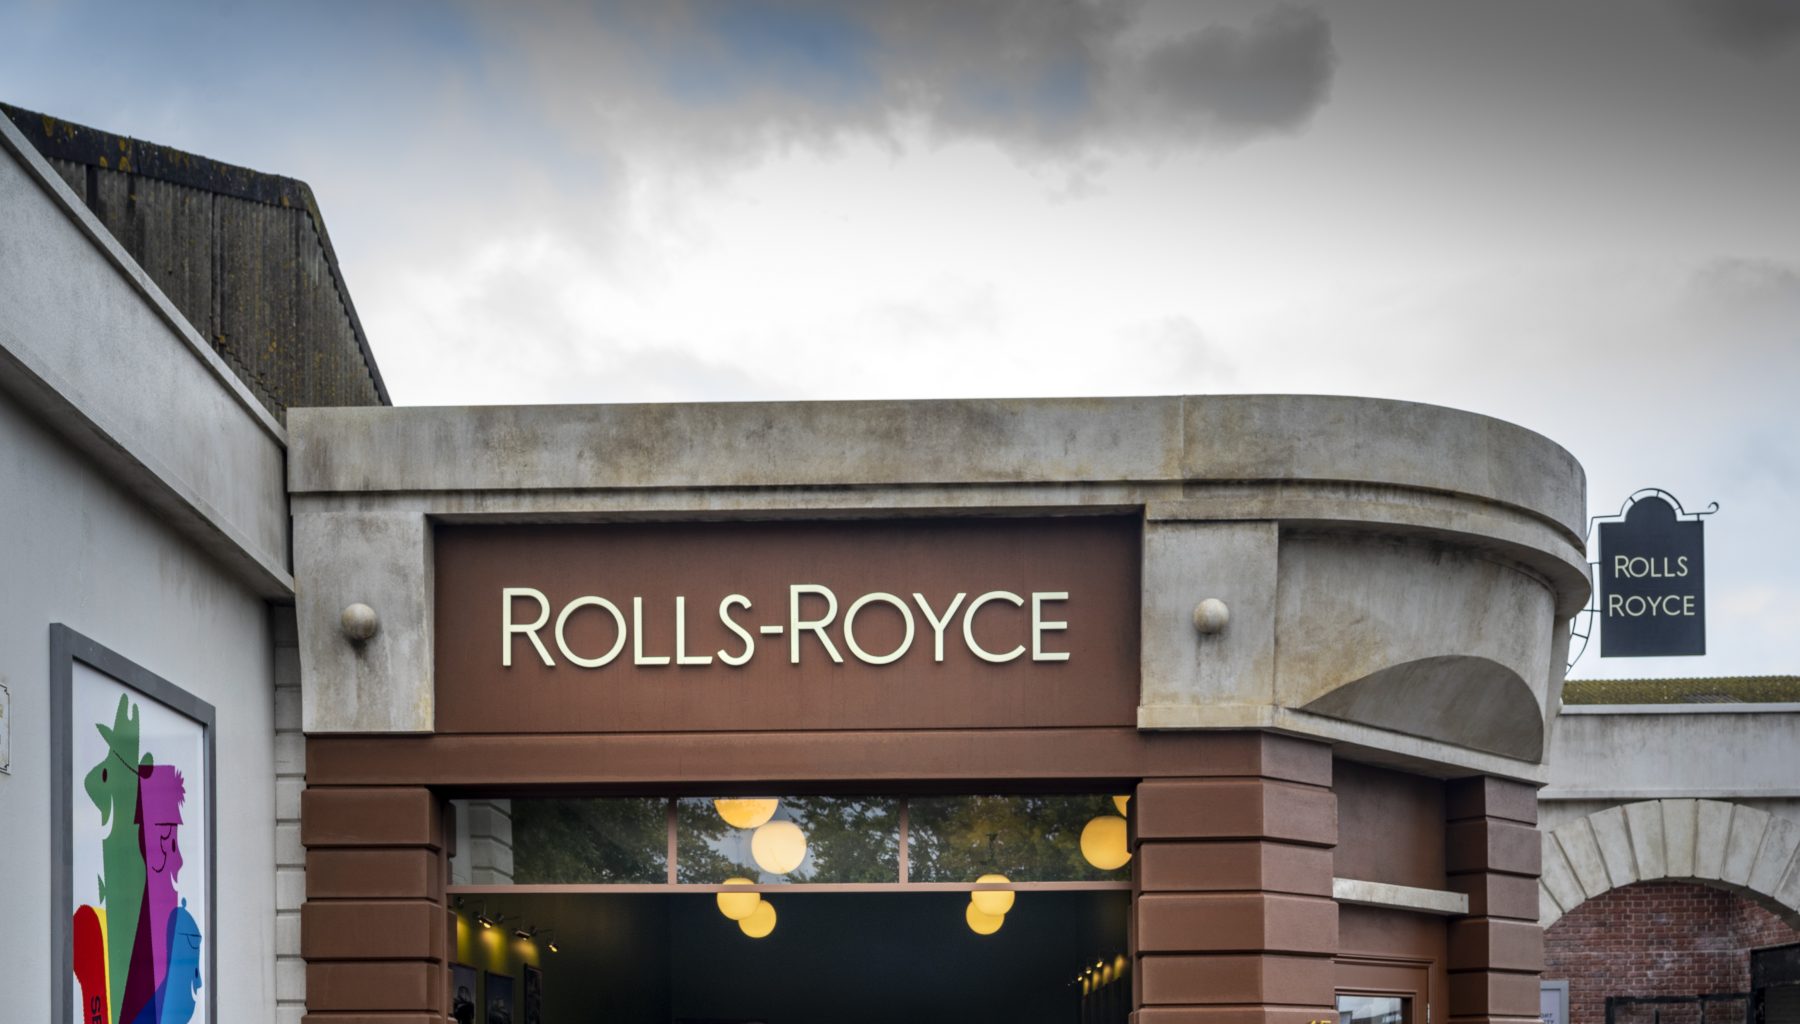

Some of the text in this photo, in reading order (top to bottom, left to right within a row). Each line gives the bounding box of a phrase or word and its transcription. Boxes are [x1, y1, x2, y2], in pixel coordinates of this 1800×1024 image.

[1615, 555, 1688, 578] ROLLS
[1609, 594, 1695, 617] ROYCE
[502, 584, 1071, 667] ROLLS-ROYCE
